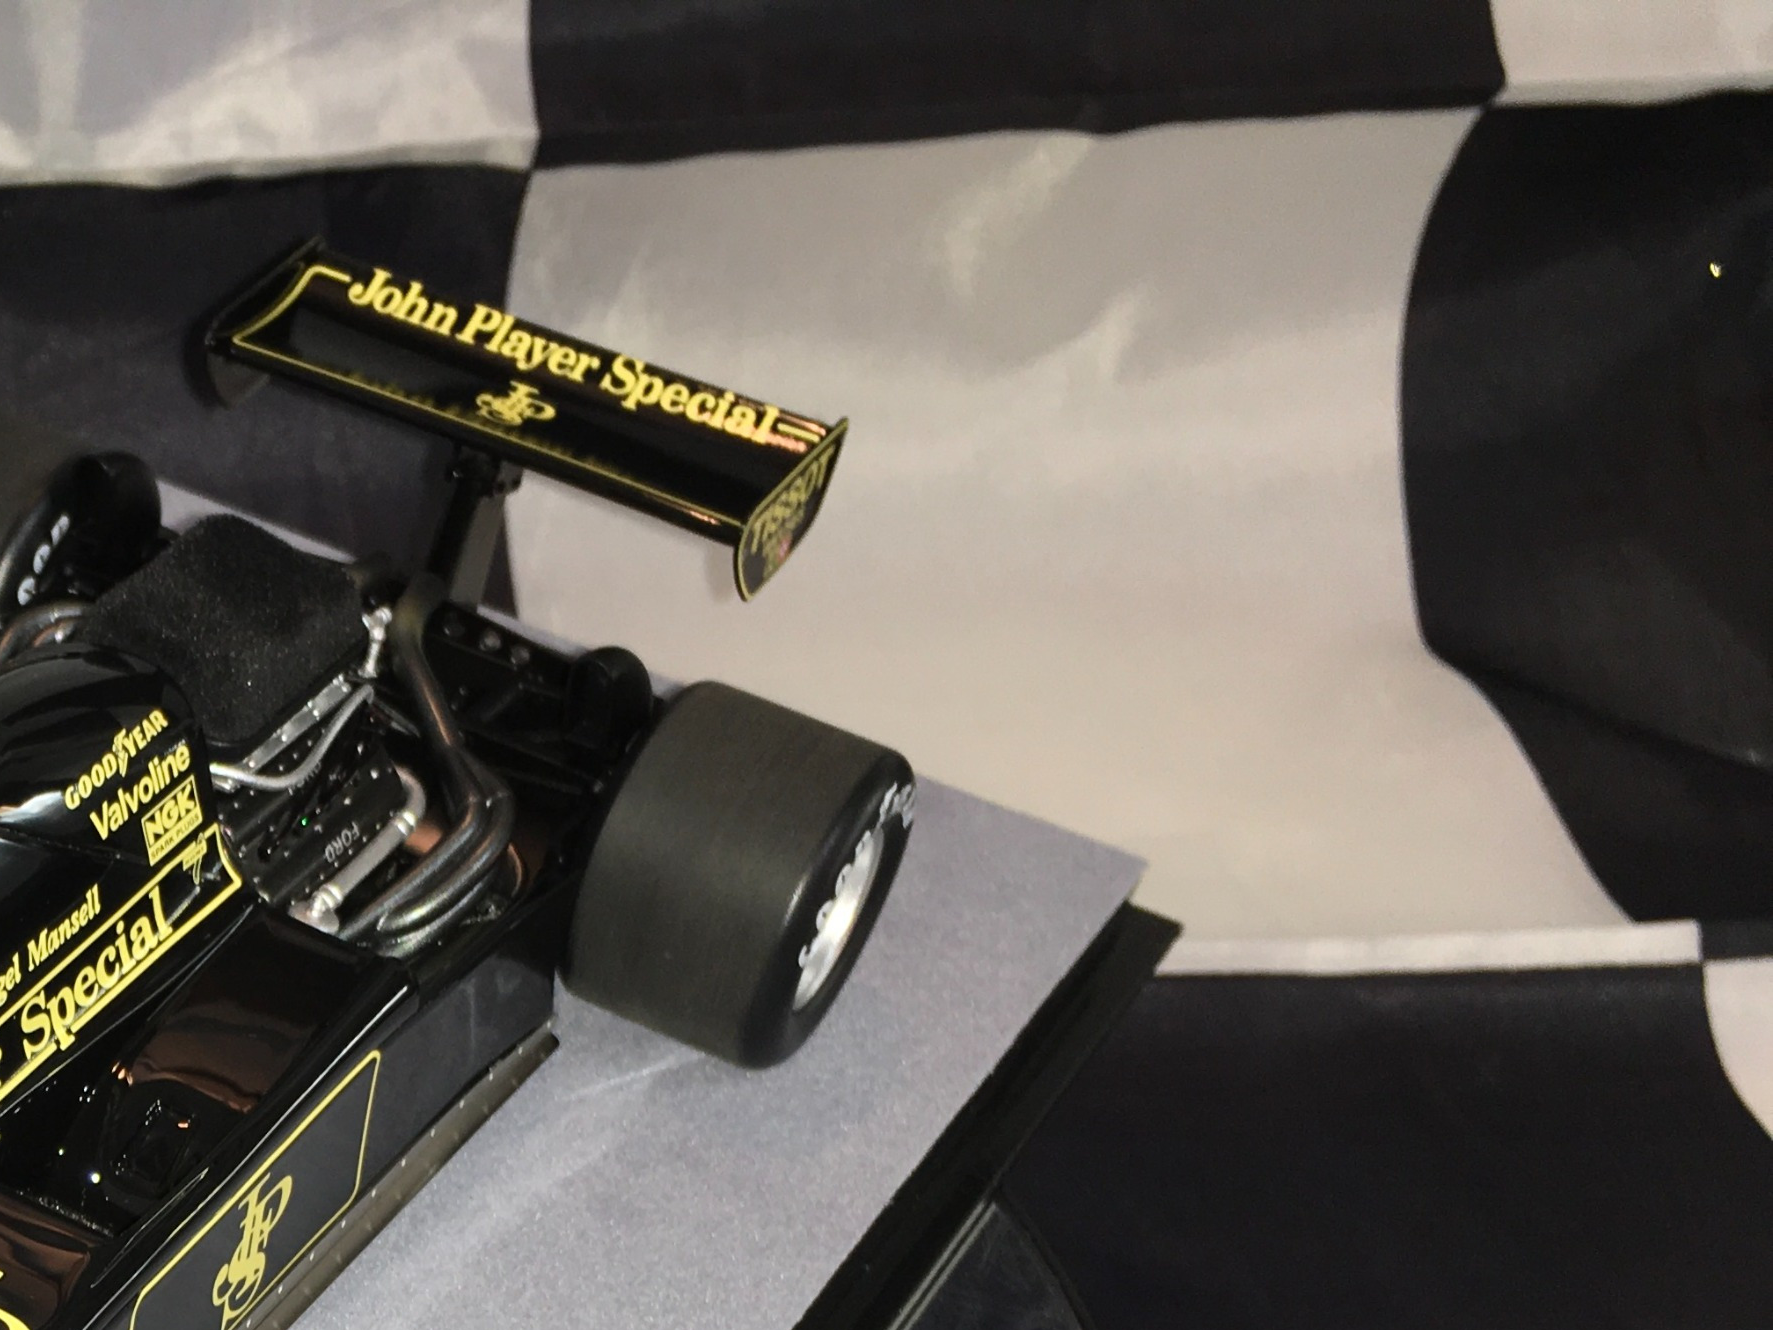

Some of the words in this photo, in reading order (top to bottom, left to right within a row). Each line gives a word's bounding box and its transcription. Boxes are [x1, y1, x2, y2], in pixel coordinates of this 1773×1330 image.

[348, 268, 459, 337] John
[456, 304, 600, 383] Player
[599, 353, 780, 444] Special
[64, 709, 169, 810] GOODYEAR
[90, 742, 191, 840] Valvoline
[144, 784, 195, 846] NGK
[19, 887, 174, 1059] Special
[27, 884, 101, 971] Mansell
